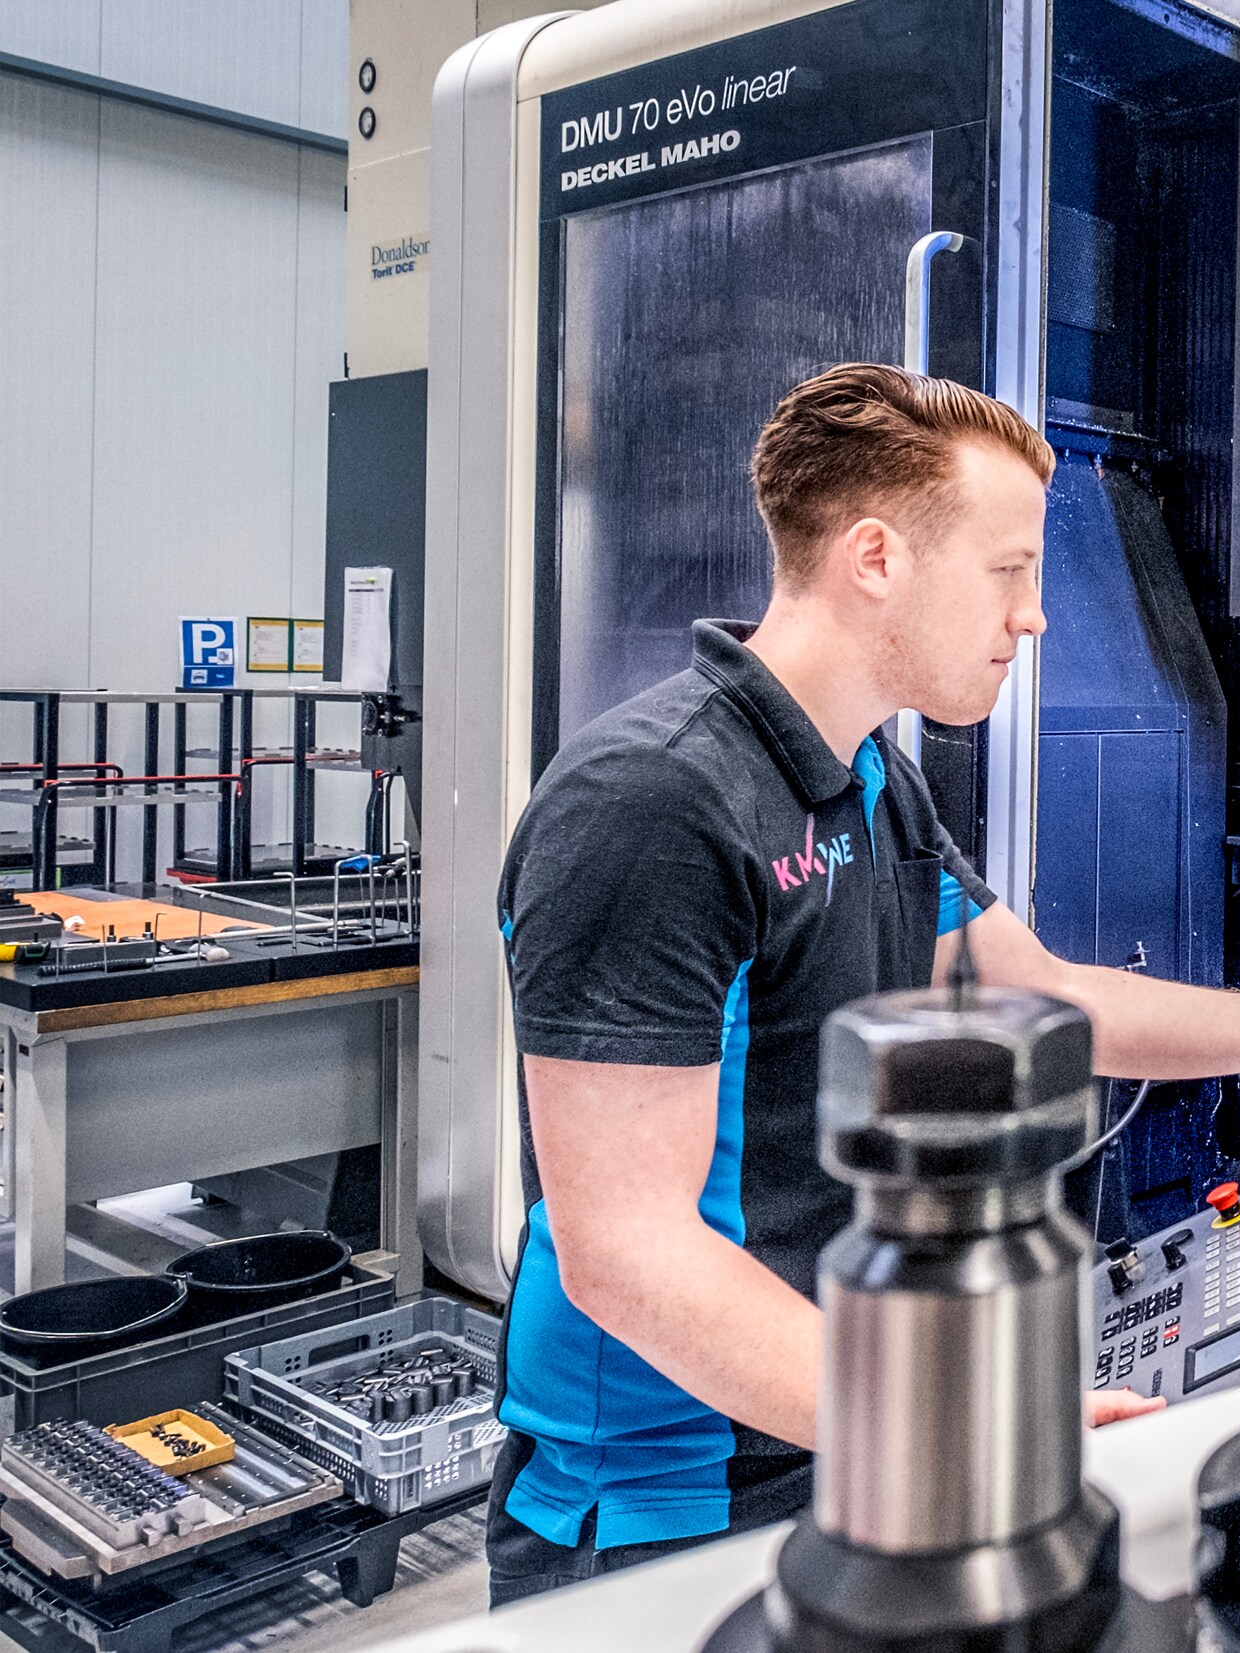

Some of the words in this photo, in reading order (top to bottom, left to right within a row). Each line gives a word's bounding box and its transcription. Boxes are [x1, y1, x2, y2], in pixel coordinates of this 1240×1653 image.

[561, 107, 623, 152] DMU
[629, 99, 660, 134] 70
[666, 84, 716, 124] eVo
[721, 66, 797, 110] linear
[561, 152, 656, 191] DECKEL
[661, 130, 741, 167] MAHO
[395, 261, 416, 275] DCE
[191, 623, 226, 664] P
[772, 812, 854, 908] KMWE
